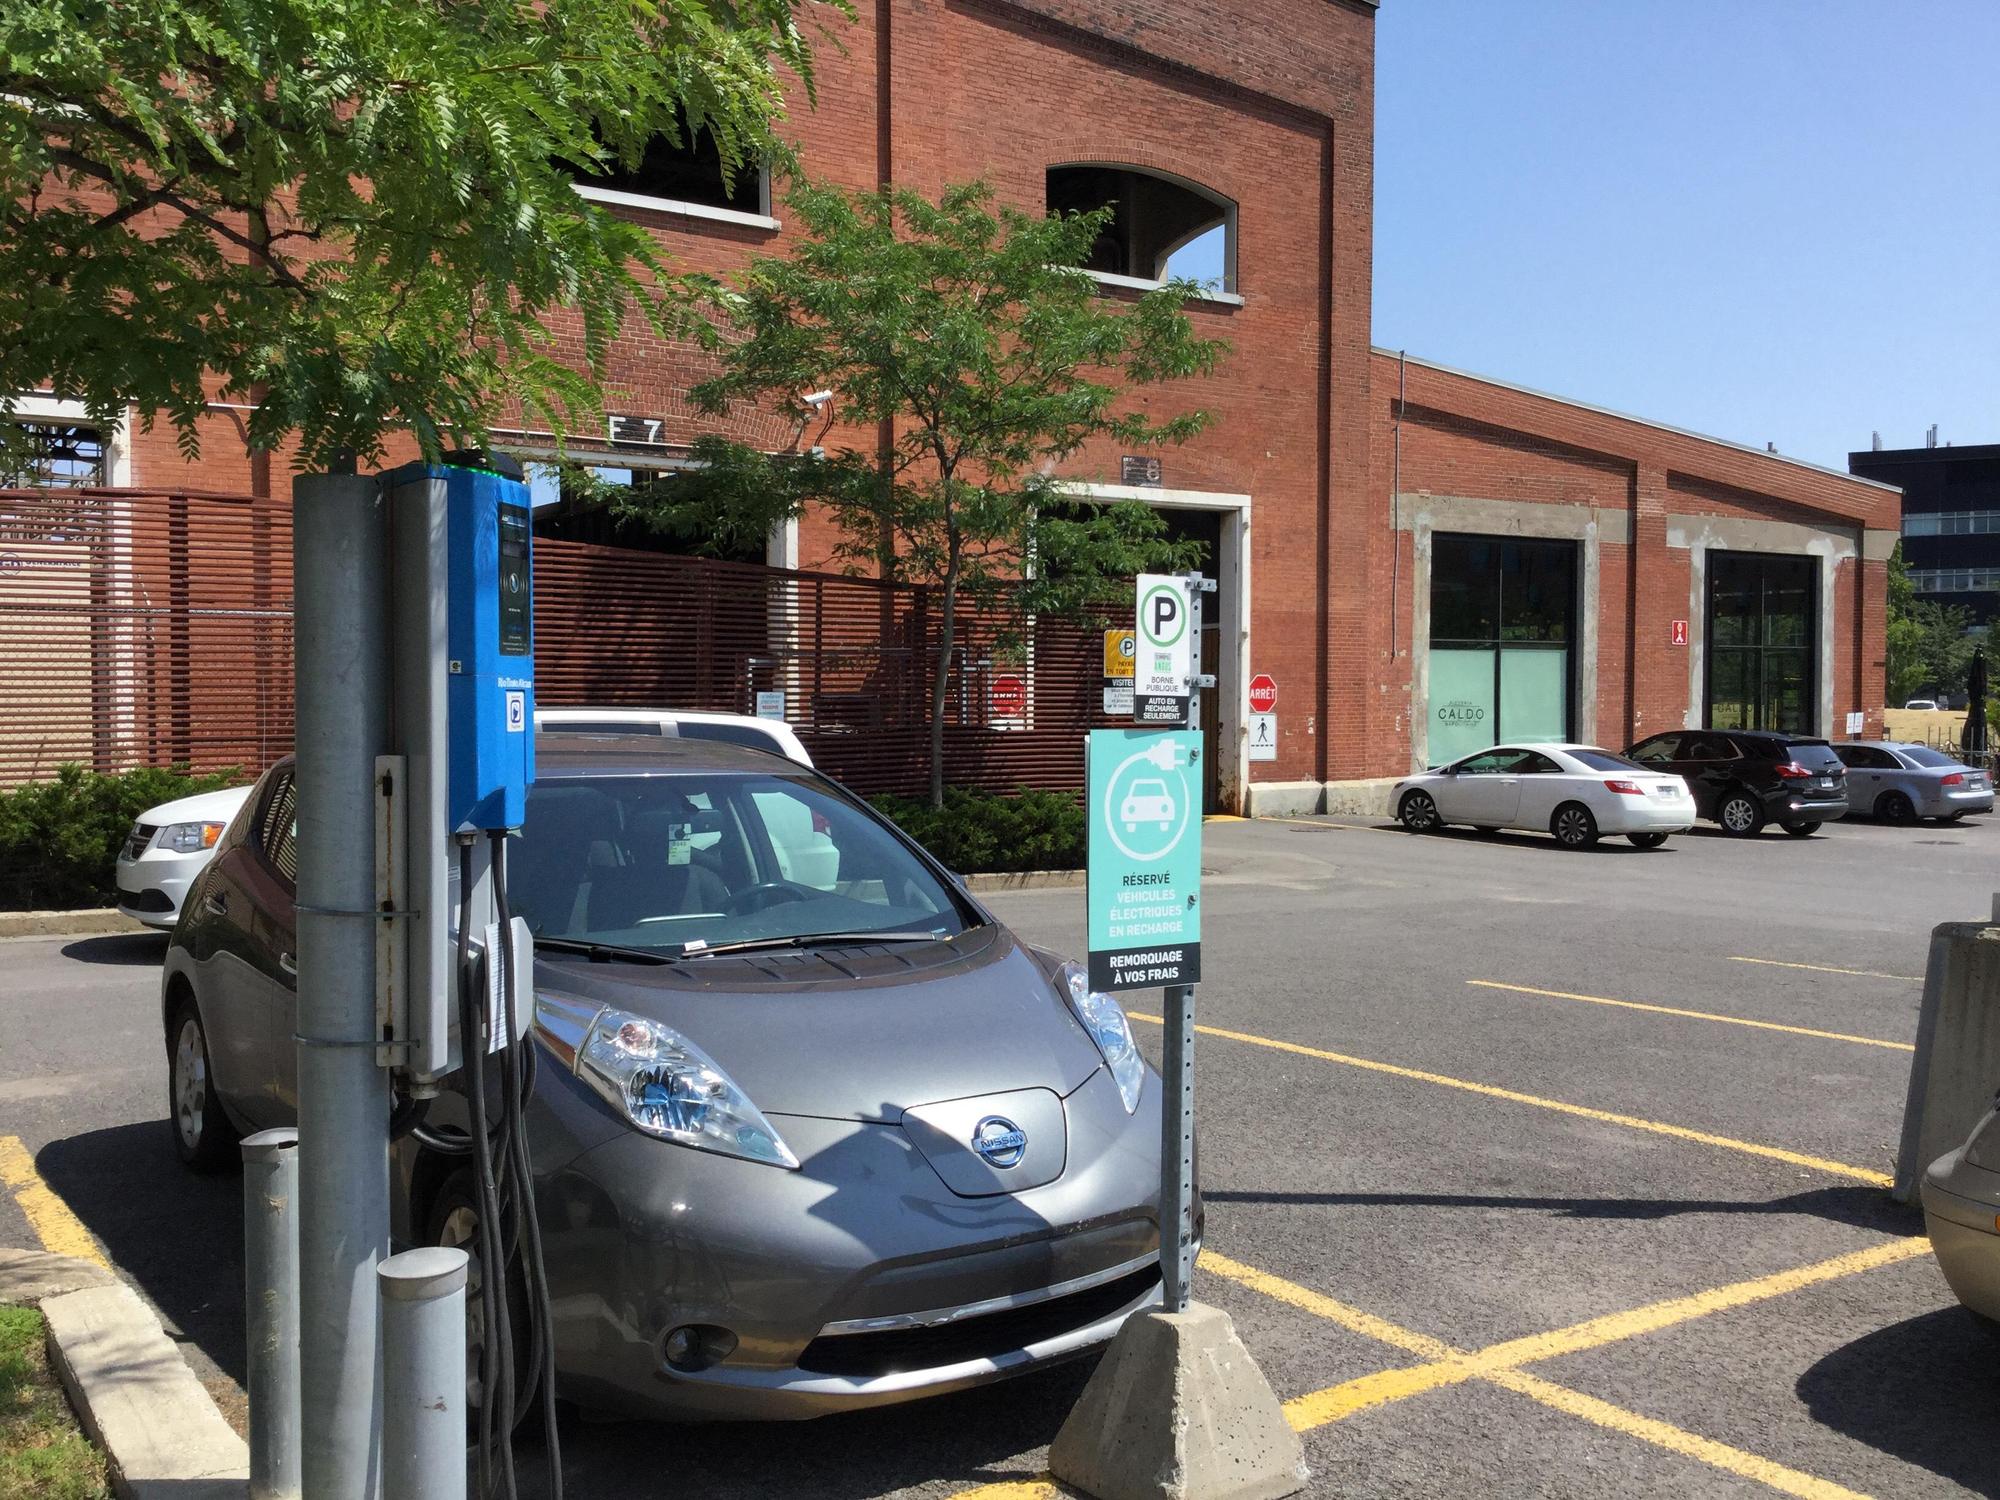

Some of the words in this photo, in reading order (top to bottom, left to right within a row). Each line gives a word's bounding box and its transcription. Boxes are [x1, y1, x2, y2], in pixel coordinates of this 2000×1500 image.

[1154, 596, 1177, 636] P
[1124, 640, 1133, 654] P
[1151, 676, 1174, 684] BORNE
[1146, 684, 1179, 692] PUBLIQUE
[1250, 686, 1275, 700] ARRÊT
[1148, 697, 1166, 705] AUTO
[1166, 697, 1176, 705] EN
[1143, 712, 1180, 720] SEULEMENT
[1438, 708, 1485, 720] CALDO
[1122, 871, 1171, 887] RÉSERVÉ
[1116, 888, 1176, 904] VÉHICULES
[1109, 904, 1182, 921] ÉLECTRIQUES
[1108, 925, 1124, 938] EN
[1126, 921, 1184, 937] RECHARGE
[1109, 950, 1183, 968] REMORQUAGE
[1114, 969, 1122, 984] À
[1124, 970, 1146, 983] VOS
[1148, 967, 1179, 981] FRAIS
[980, 1134, 1024, 1149] NISSAN
